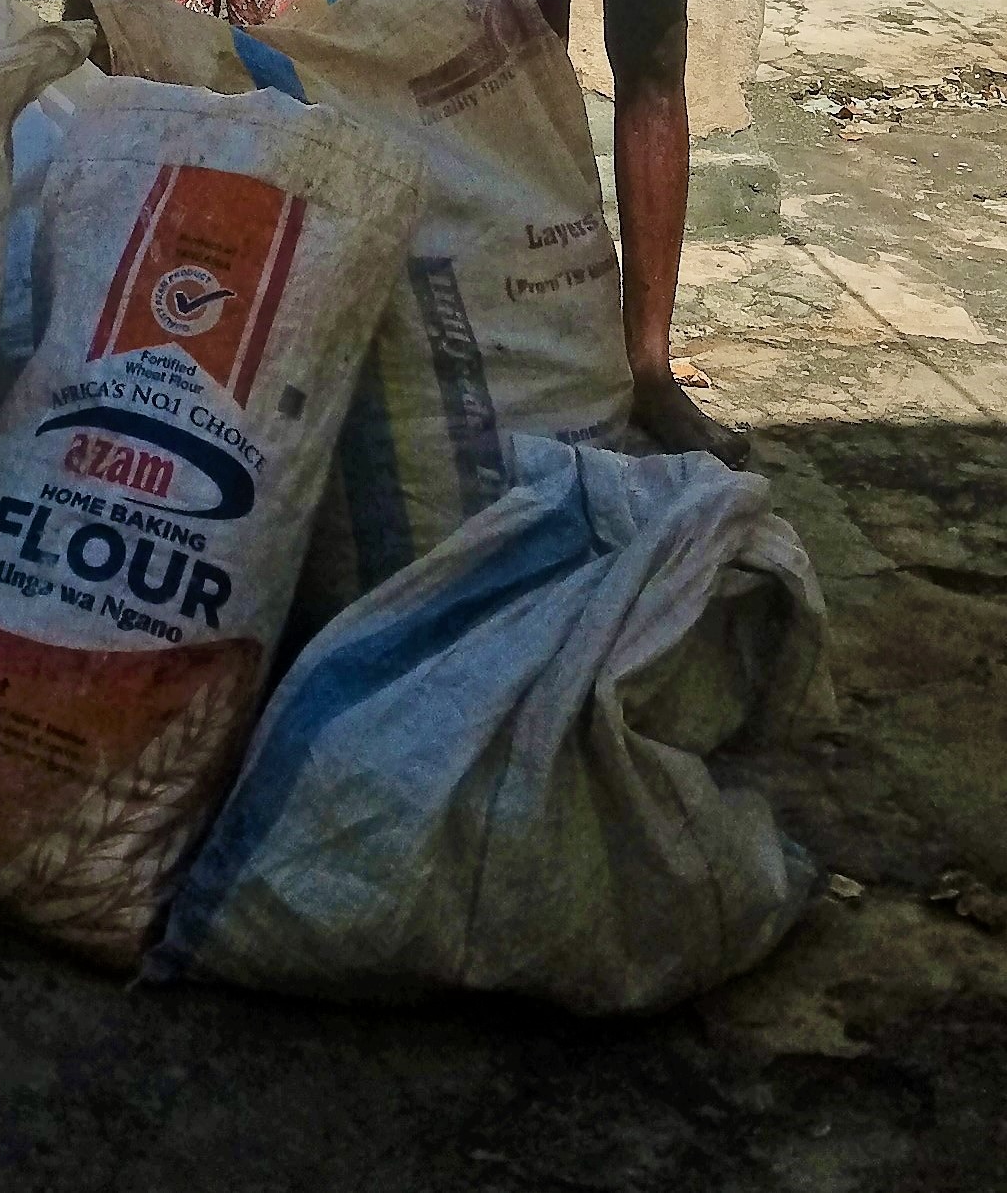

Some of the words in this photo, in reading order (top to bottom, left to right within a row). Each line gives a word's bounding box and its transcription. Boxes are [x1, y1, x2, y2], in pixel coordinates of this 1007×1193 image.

[525, 214, 599, 249] Layers
[124, 360, 167, 384] Wheat
[168, 373, 205, 395] Flour
[140, 349, 199, 377] Fortified
[50, 377, 126, 408] AFRICA'S
[63, 432, 175, 499] azam
[39, 483, 107, 519] HOME
[109, 502, 207, 553] BAKING
[59, 584, 96, 612] wa
[100, 594, 183, 644] Ngano
